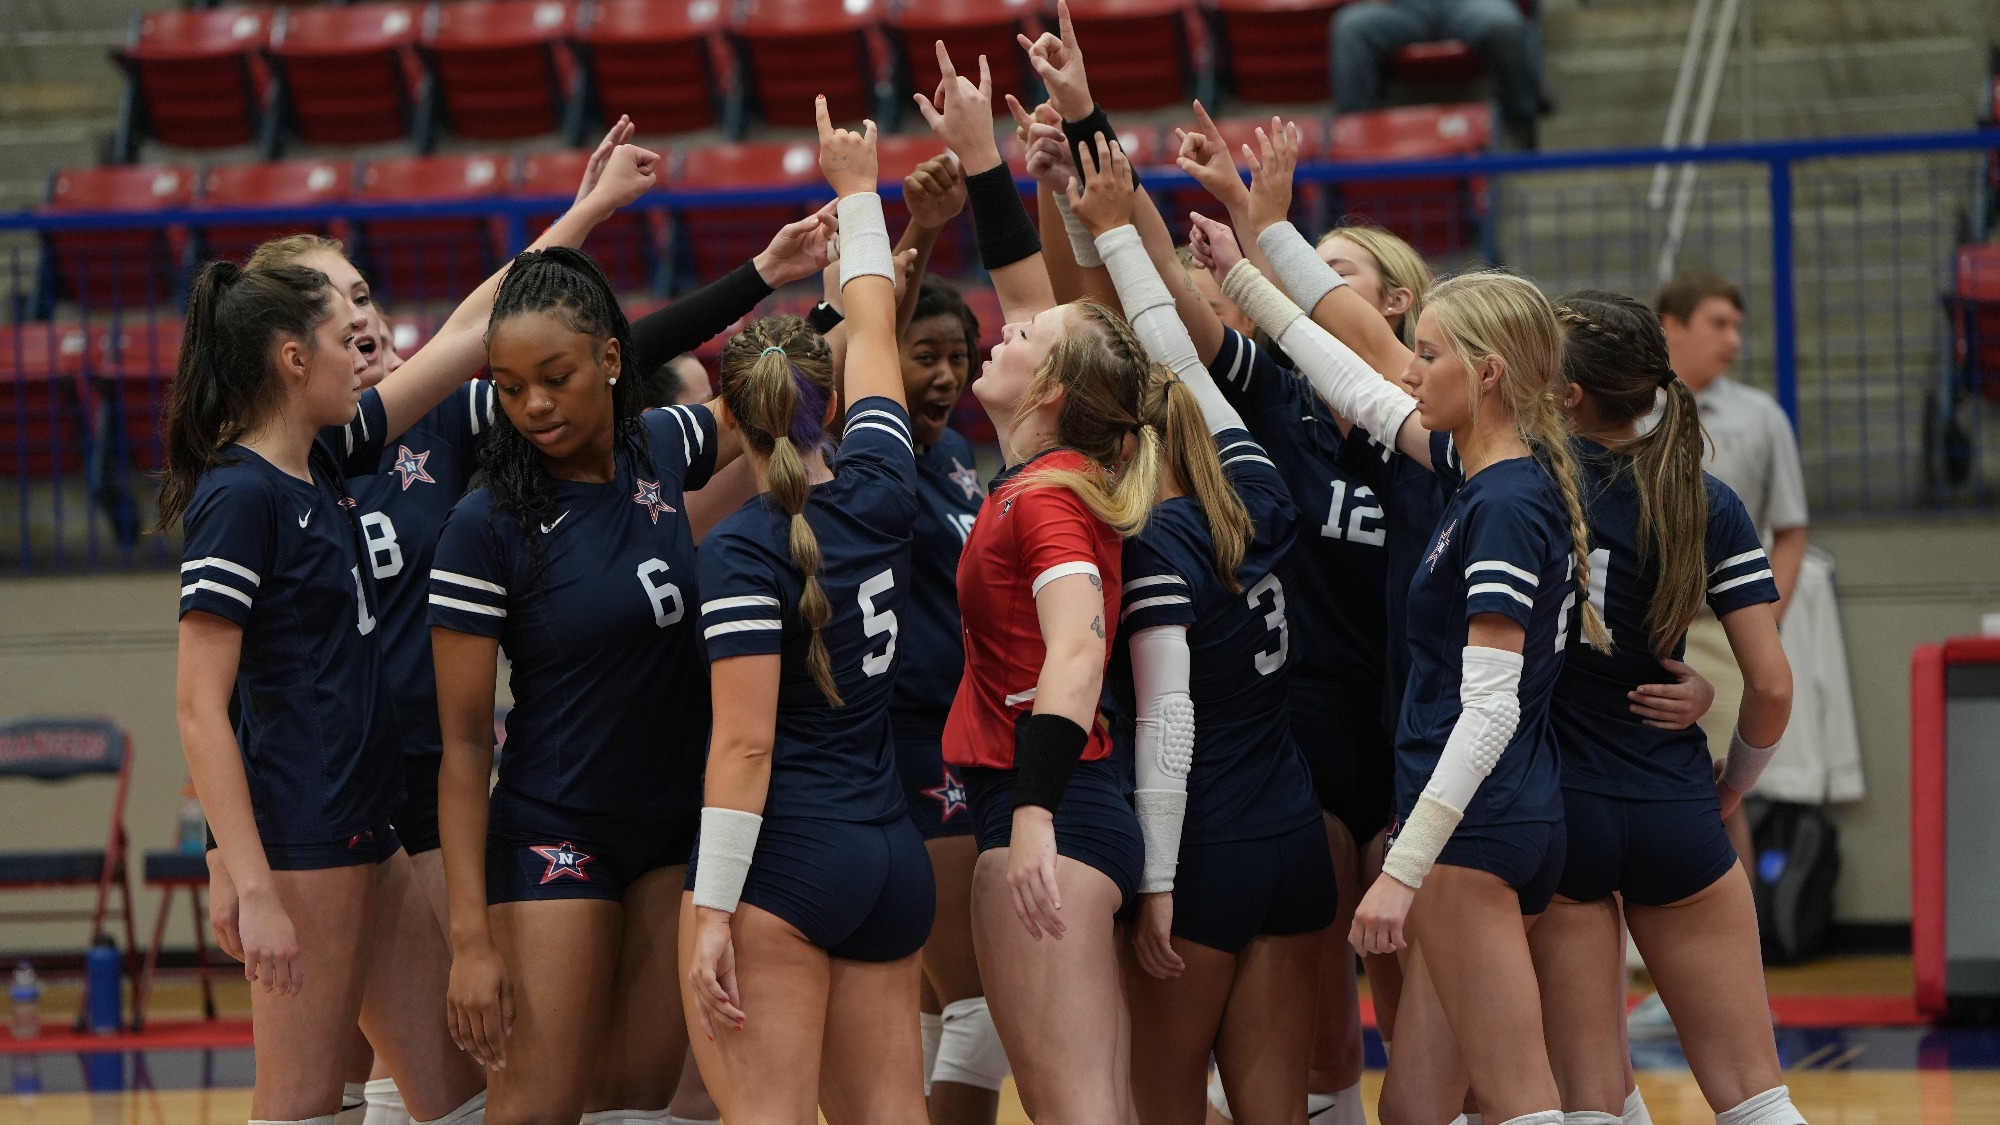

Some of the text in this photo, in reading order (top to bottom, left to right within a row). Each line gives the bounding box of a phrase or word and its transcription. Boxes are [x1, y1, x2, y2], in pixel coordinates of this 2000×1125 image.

[1321, 479, 1386, 547] 12
[637, 557, 685, 628] 6
[857, 568, 898, 677] 5
[1246, 572, 1288, 676] 3
[558, 852, 574, 866] N
